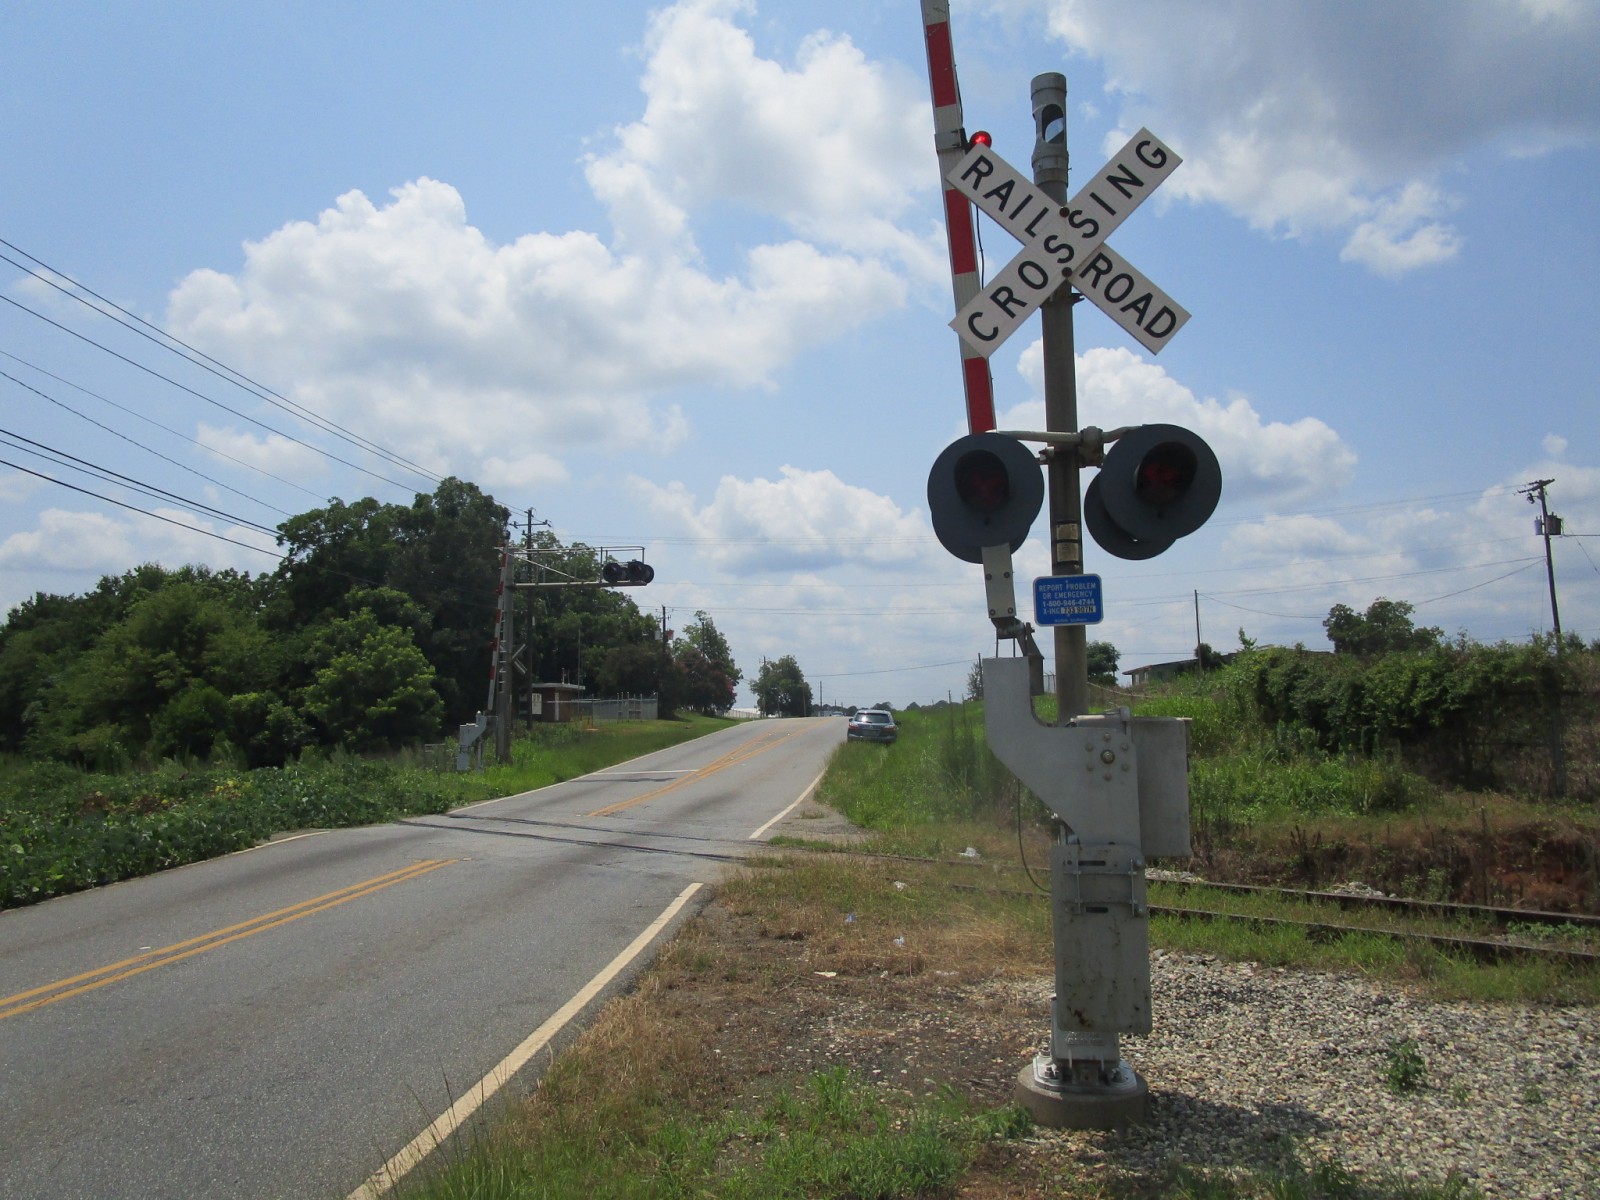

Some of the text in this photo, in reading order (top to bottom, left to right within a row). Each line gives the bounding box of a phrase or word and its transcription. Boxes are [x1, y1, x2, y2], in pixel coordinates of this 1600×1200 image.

[967, 140, 1167, 342] CROSSING
[960, 154, 1177, 339] RAIL ROAD
[1038, 582, 1096, 592] REPORT PROBLEM
[1054, 591, 1093, 599] EMERGENCY
[1043, 607, 1060, 615] X-ING
